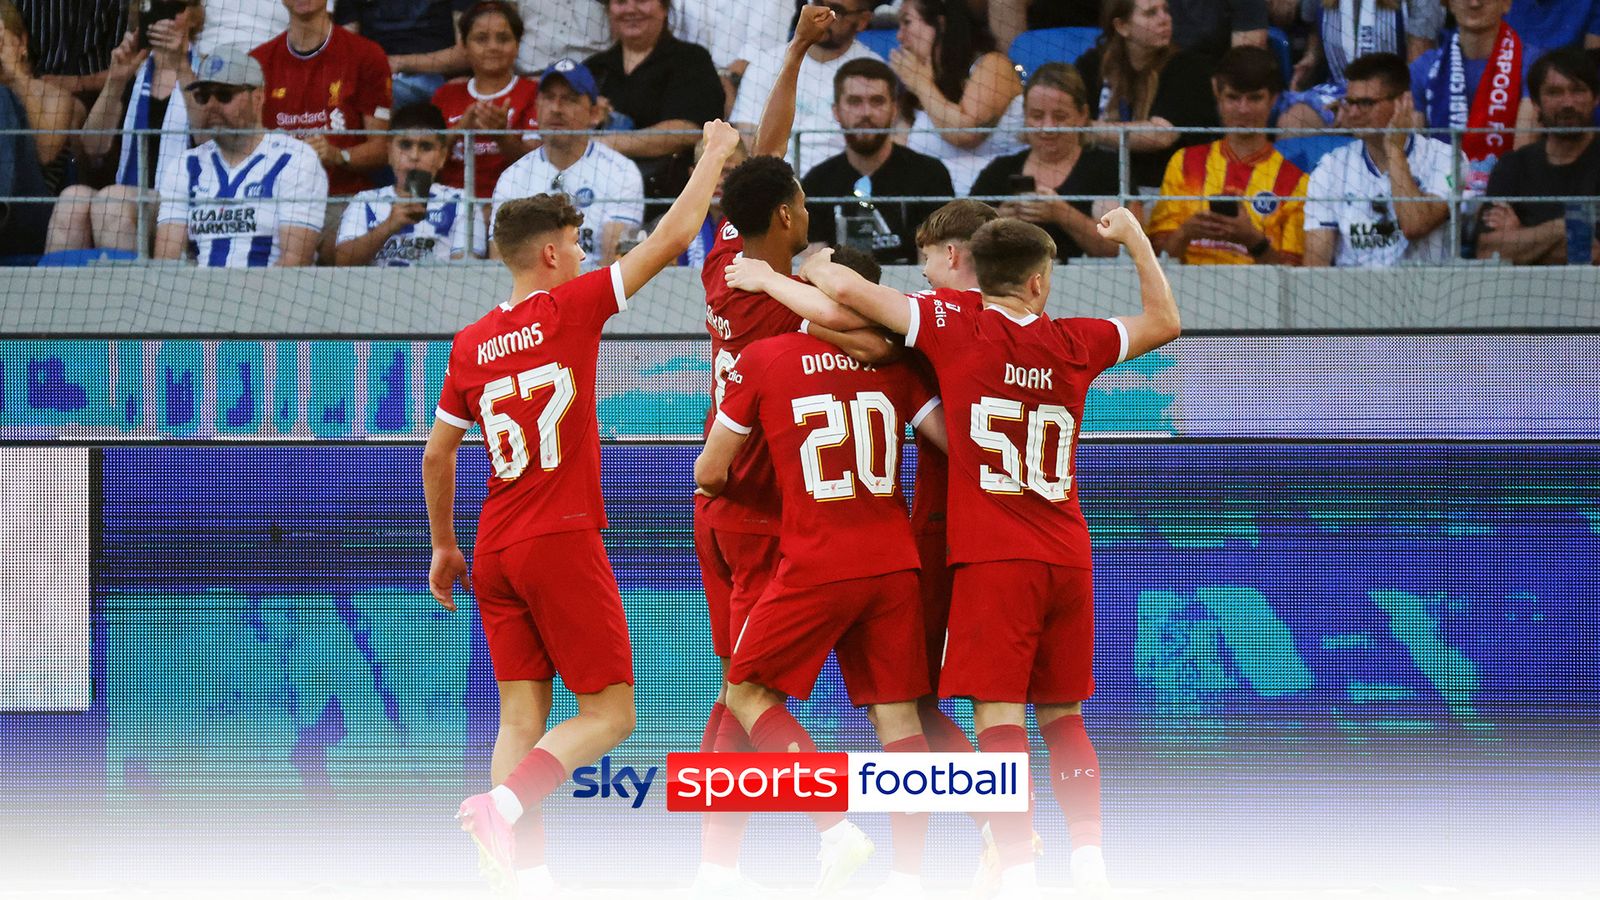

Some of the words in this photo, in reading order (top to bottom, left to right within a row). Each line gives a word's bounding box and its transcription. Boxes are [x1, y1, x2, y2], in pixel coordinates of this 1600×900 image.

[276, 109, 328, 126] Standard
[477, 322, 544, 366] KOUMAS
[801, 352, 860, 375] DIOGO
[1004, 362, 1053, 390] DOAK
[479, 362, 576, 481] 67
[791, 391, 900, 501] 20
[970, 396, 1076, 502] 50
